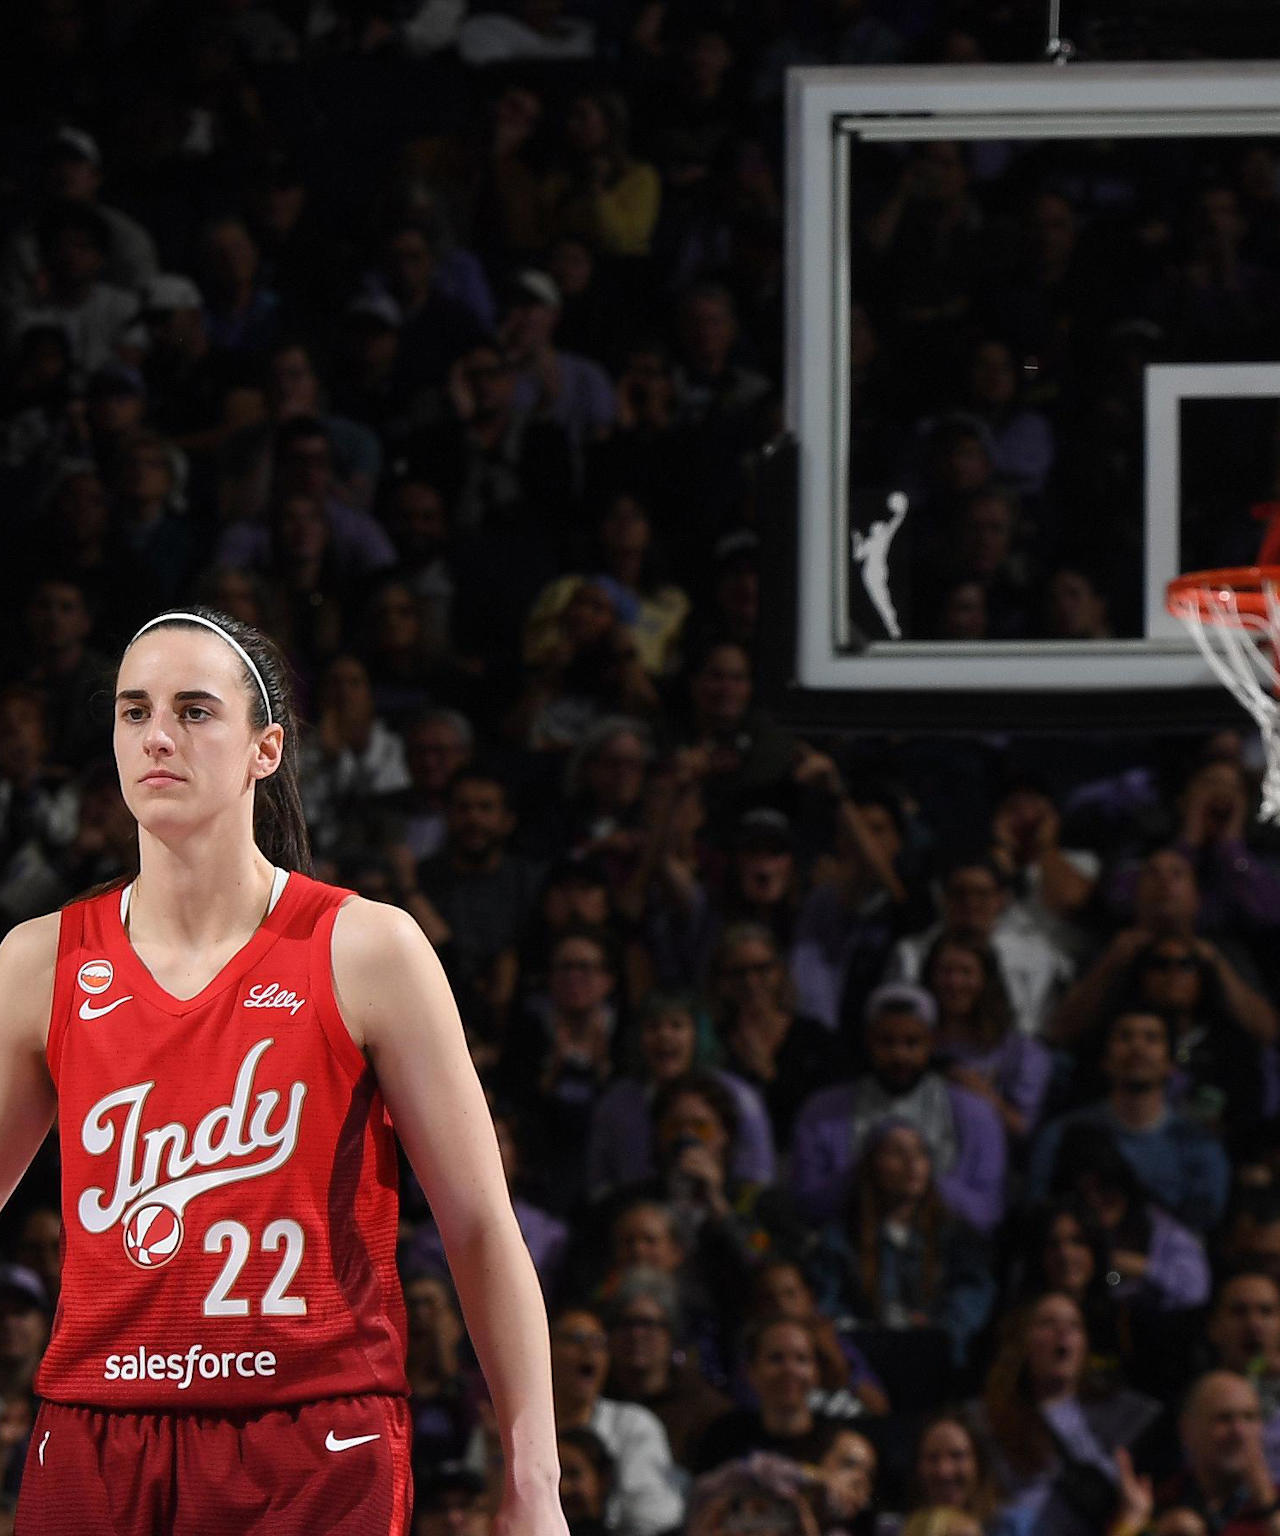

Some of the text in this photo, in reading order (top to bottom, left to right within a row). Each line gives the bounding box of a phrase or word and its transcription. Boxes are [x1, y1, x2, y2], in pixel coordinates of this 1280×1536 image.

[243, 982, 306, 1015] Lilly
[78, 1037, 308, 1234] Indy
[202, 1218, 308, 1317] 22
[104, 1344, 277, 1389] salesforce
